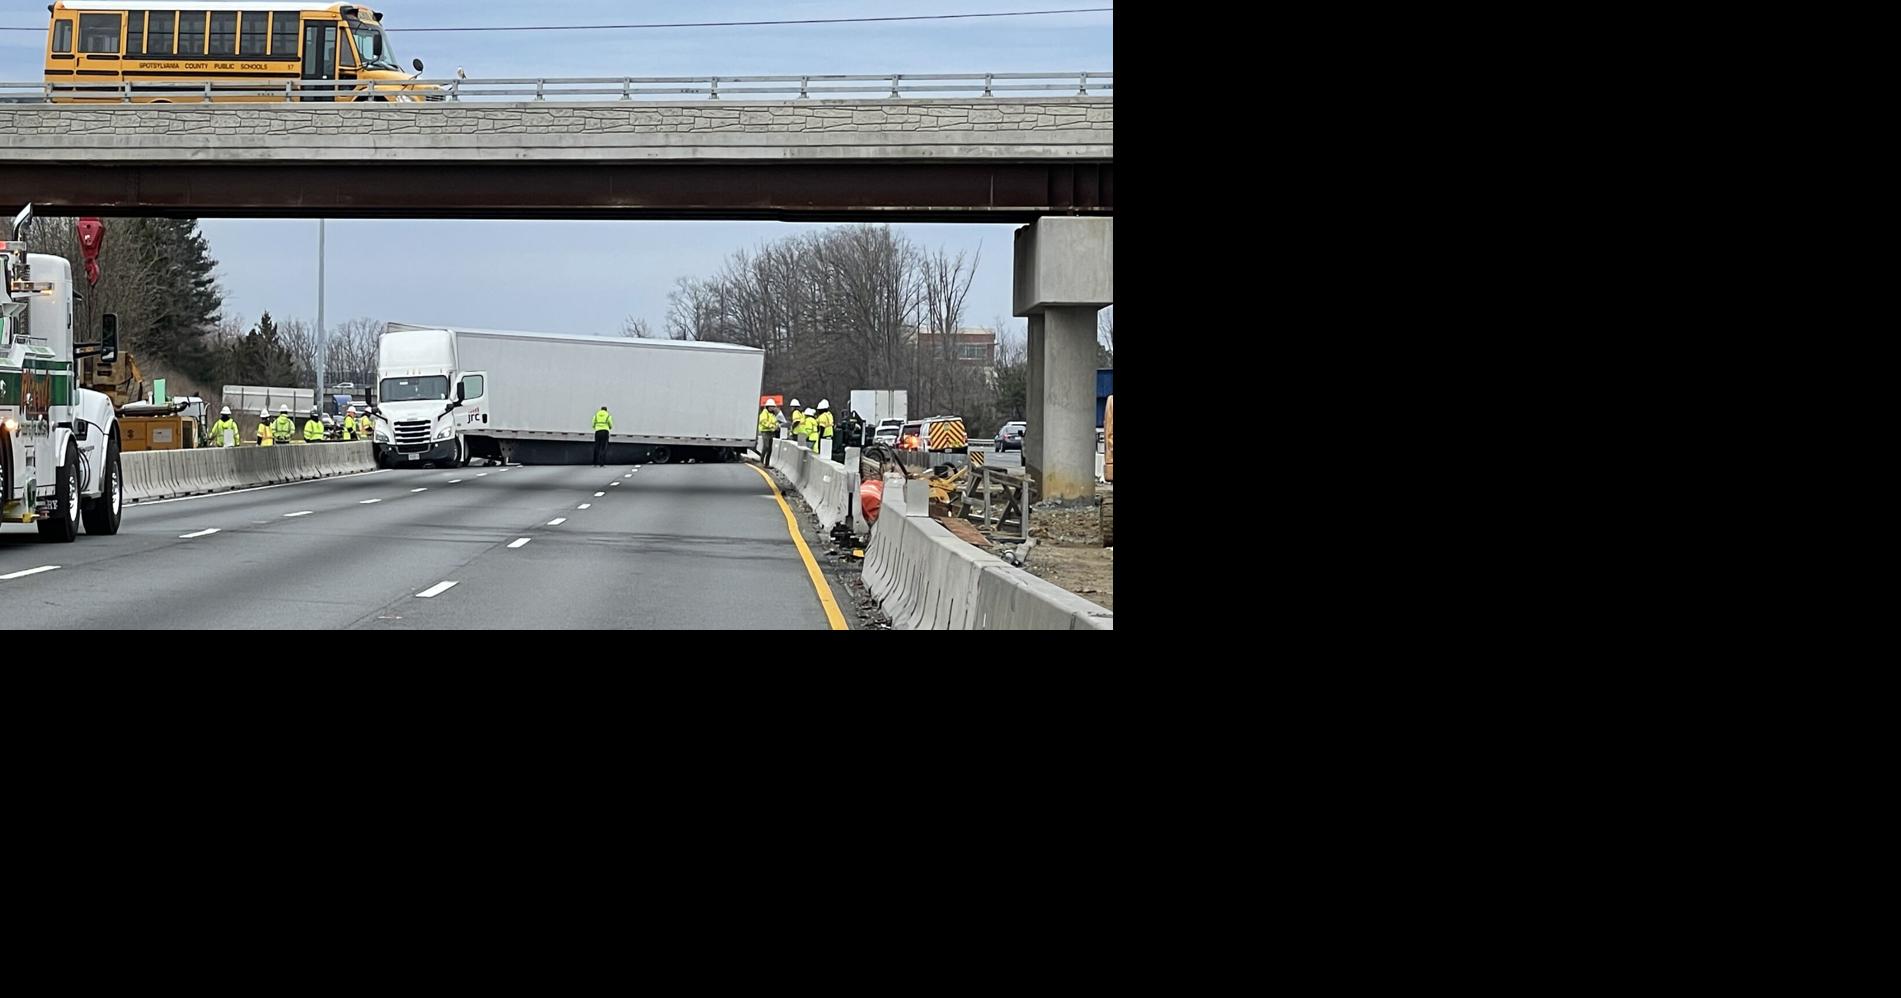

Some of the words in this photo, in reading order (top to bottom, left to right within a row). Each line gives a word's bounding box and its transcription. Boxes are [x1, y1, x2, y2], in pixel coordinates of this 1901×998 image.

[184, 62, 209, 70] COUNTY
[214, 62, 235, 70] PUBLIC
[240, 63, 269, 71] SCHOOLS
